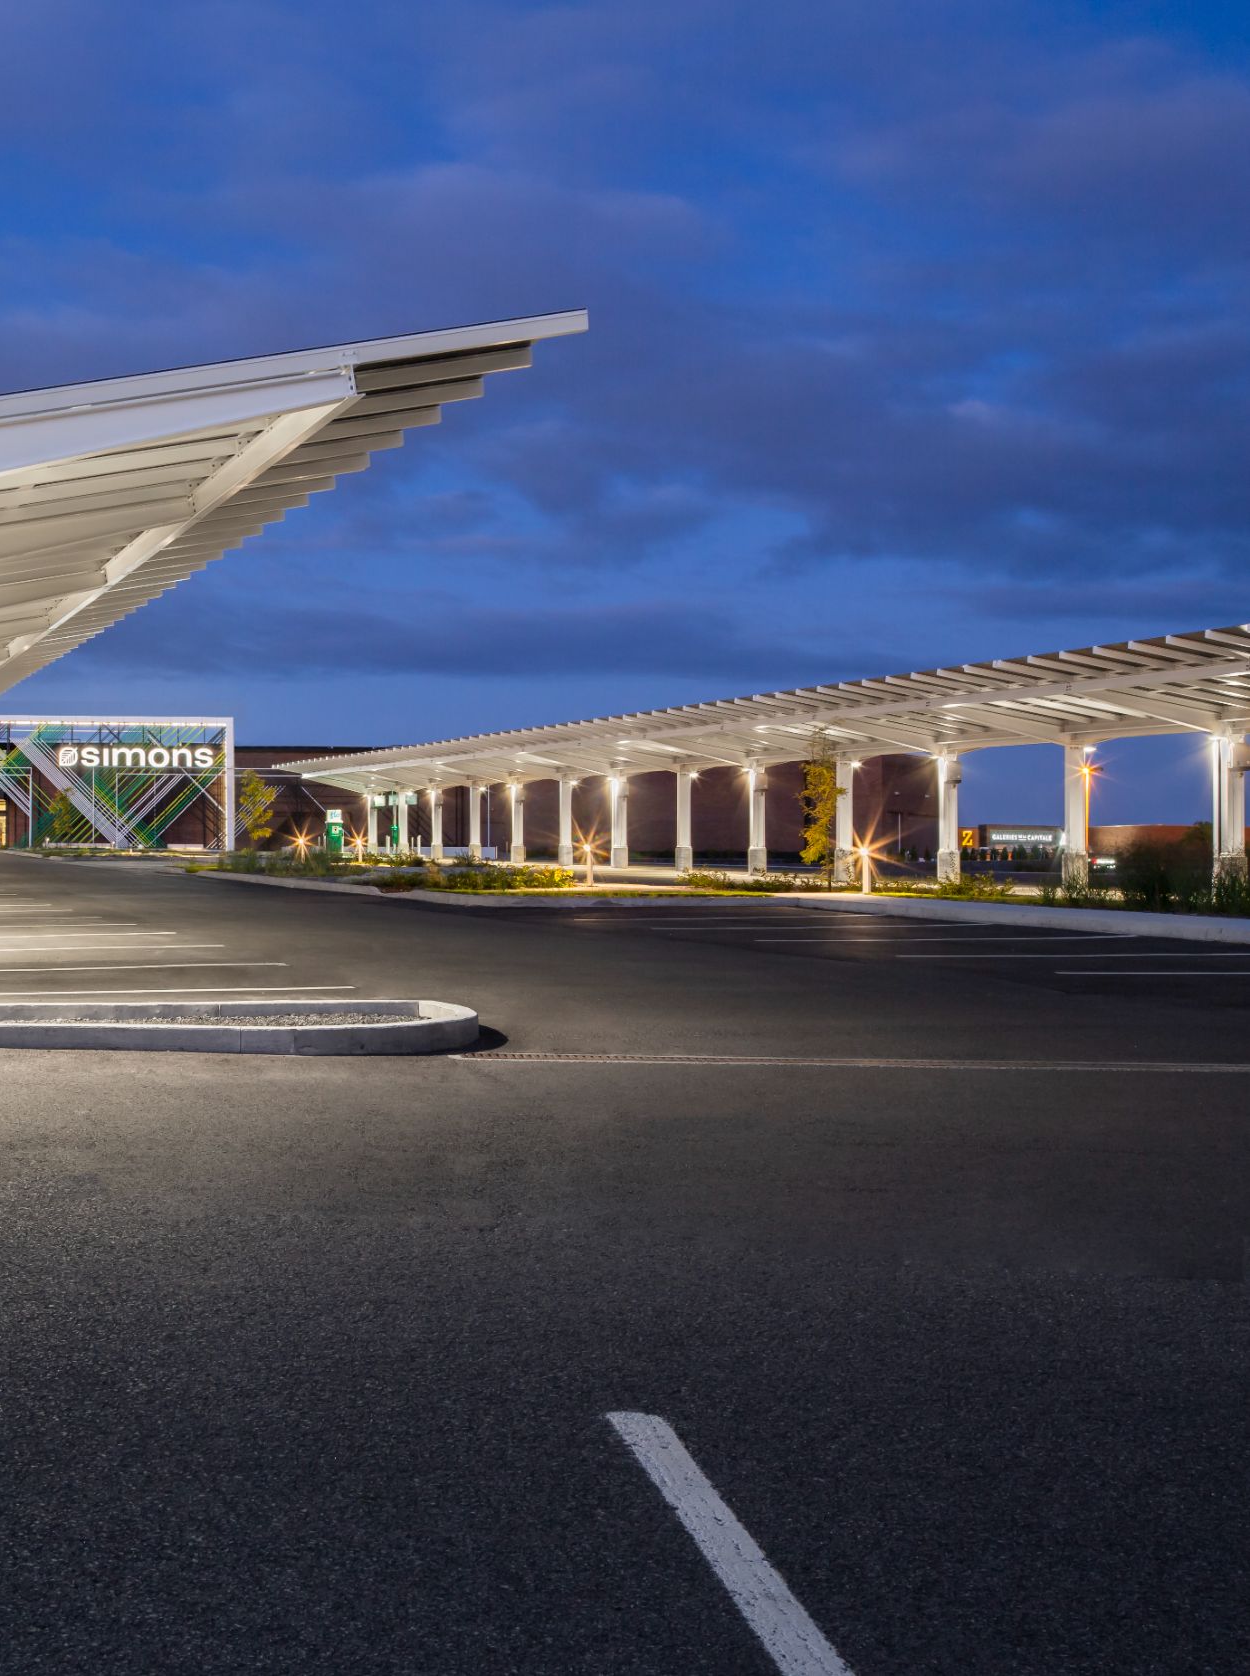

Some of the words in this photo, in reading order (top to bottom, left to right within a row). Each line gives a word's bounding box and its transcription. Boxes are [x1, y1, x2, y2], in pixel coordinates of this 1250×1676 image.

[80, 747, 214, 767] simons
[962, 830, 973, 846] Z
[1027, 834, 1053, 842] CAPITALE
